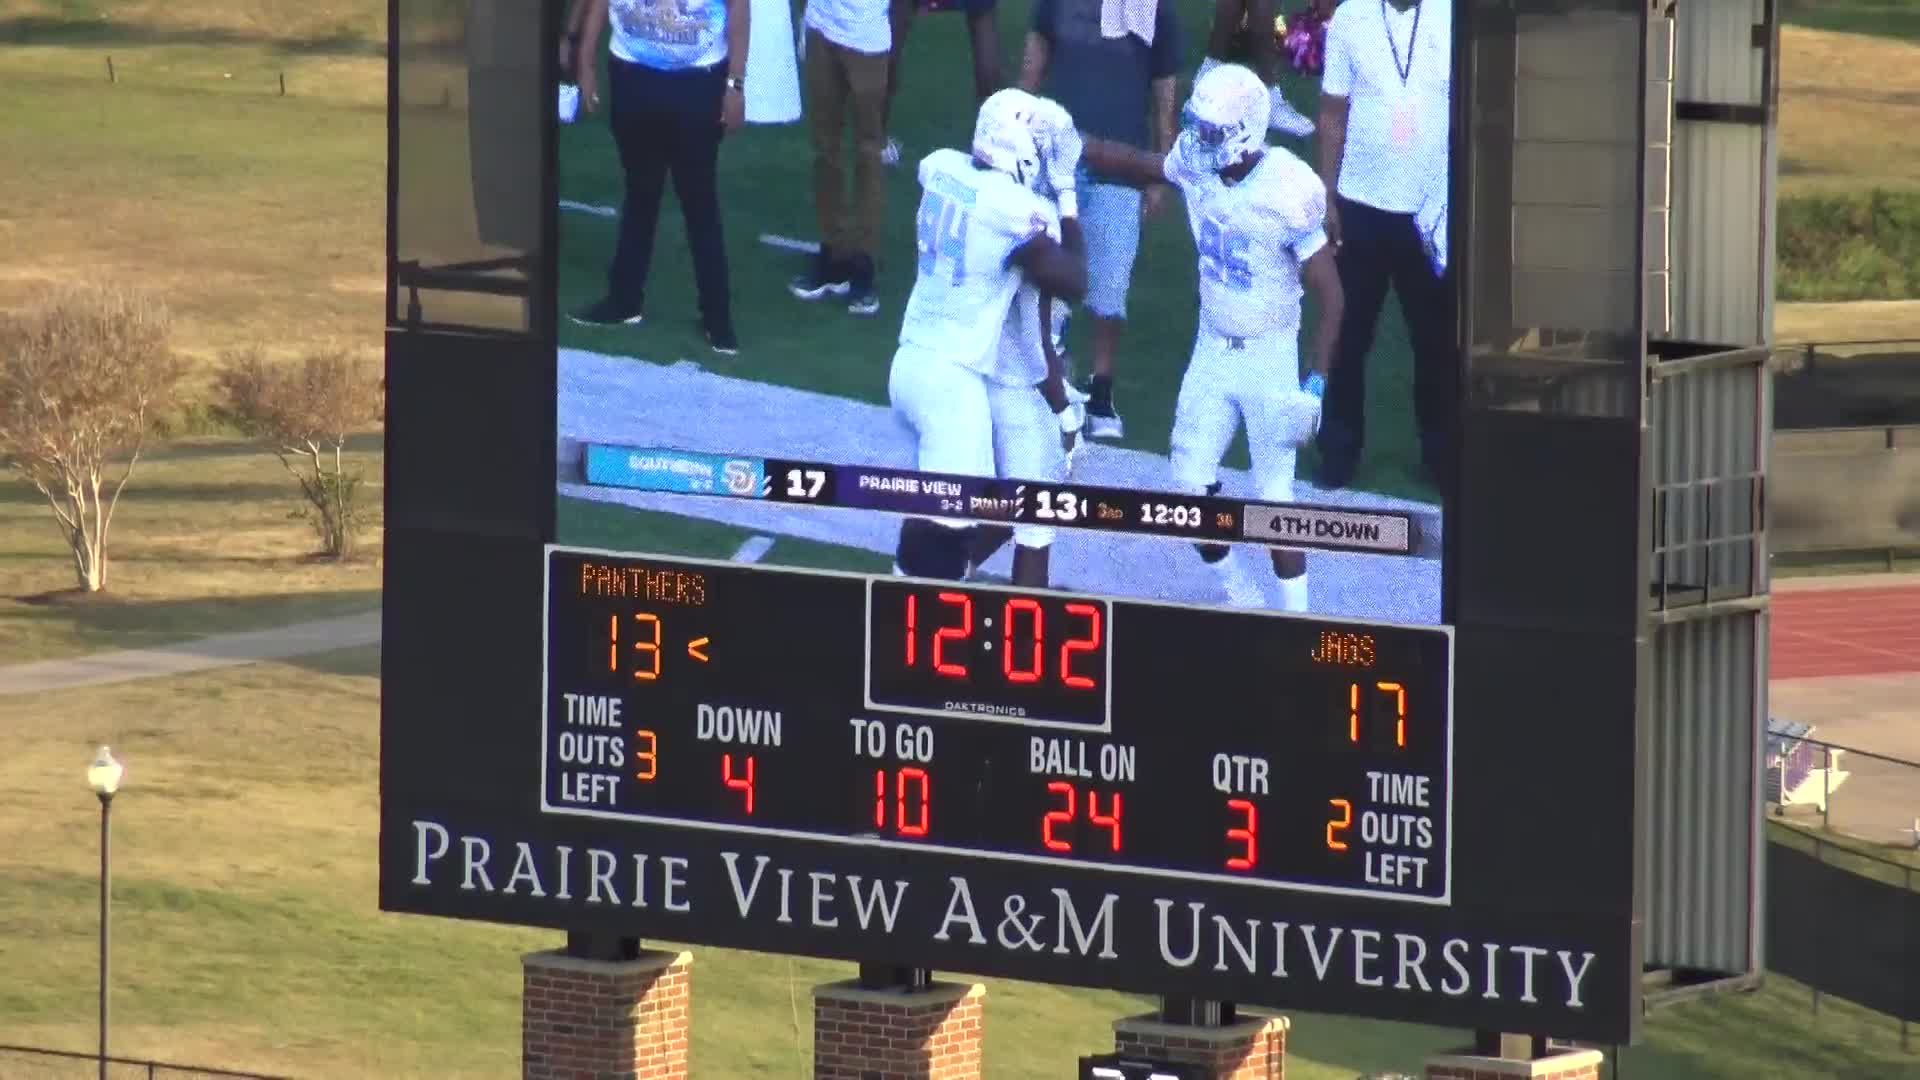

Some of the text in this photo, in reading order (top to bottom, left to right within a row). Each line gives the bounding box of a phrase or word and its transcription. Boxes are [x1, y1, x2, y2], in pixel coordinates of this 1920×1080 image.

[786, 469, 826, 498] 17
[859, 475, 962, 496] PRAIRIE VIEW
[1035, 490, 1077, 521] 13
[1140, 503, 1201, 527] 12:03
[1269, 515, 1379, 541] 4TH DOWN
[582, 563, 705, 605] PANTHERS
[610, 613, 661, 680] 13
[906, 592, 1100, 688] 12:02
[1311, 631, 1375, 666] JAGS
[563, 693, 622, 727] TIME
[697, 703, 781, 746] DOWN
[944, 701, 1026, 717] DAKTRONICS
[1350, 681, 1405, 747] 17
[559, 731, 624, 767] OUTS
[637, 730, 657, 780] 3
[850, 719, 934, 763] TO GO
[1030, 736, 1136, 782] BALL ON
[561, 771, 621, 805] LEFT
[721, 754, 754, 814] 4
[1212, 753, 1269, 794] QTR
[1366, 771, 1430, 807] TIME
[876, 767, 930, 836] 10
[1043, 781, 1121, 852] 24
[1226, 799, 1257, 868] 3
[1326, 799, 1351, 849] 2
[1361, 811, 1433, 848] OUTS
[1365, 851, 1428, 888] LEFT
[412, 820, 1597, 1008] PRAIRIE VIEW A&M UNIVERSITY
